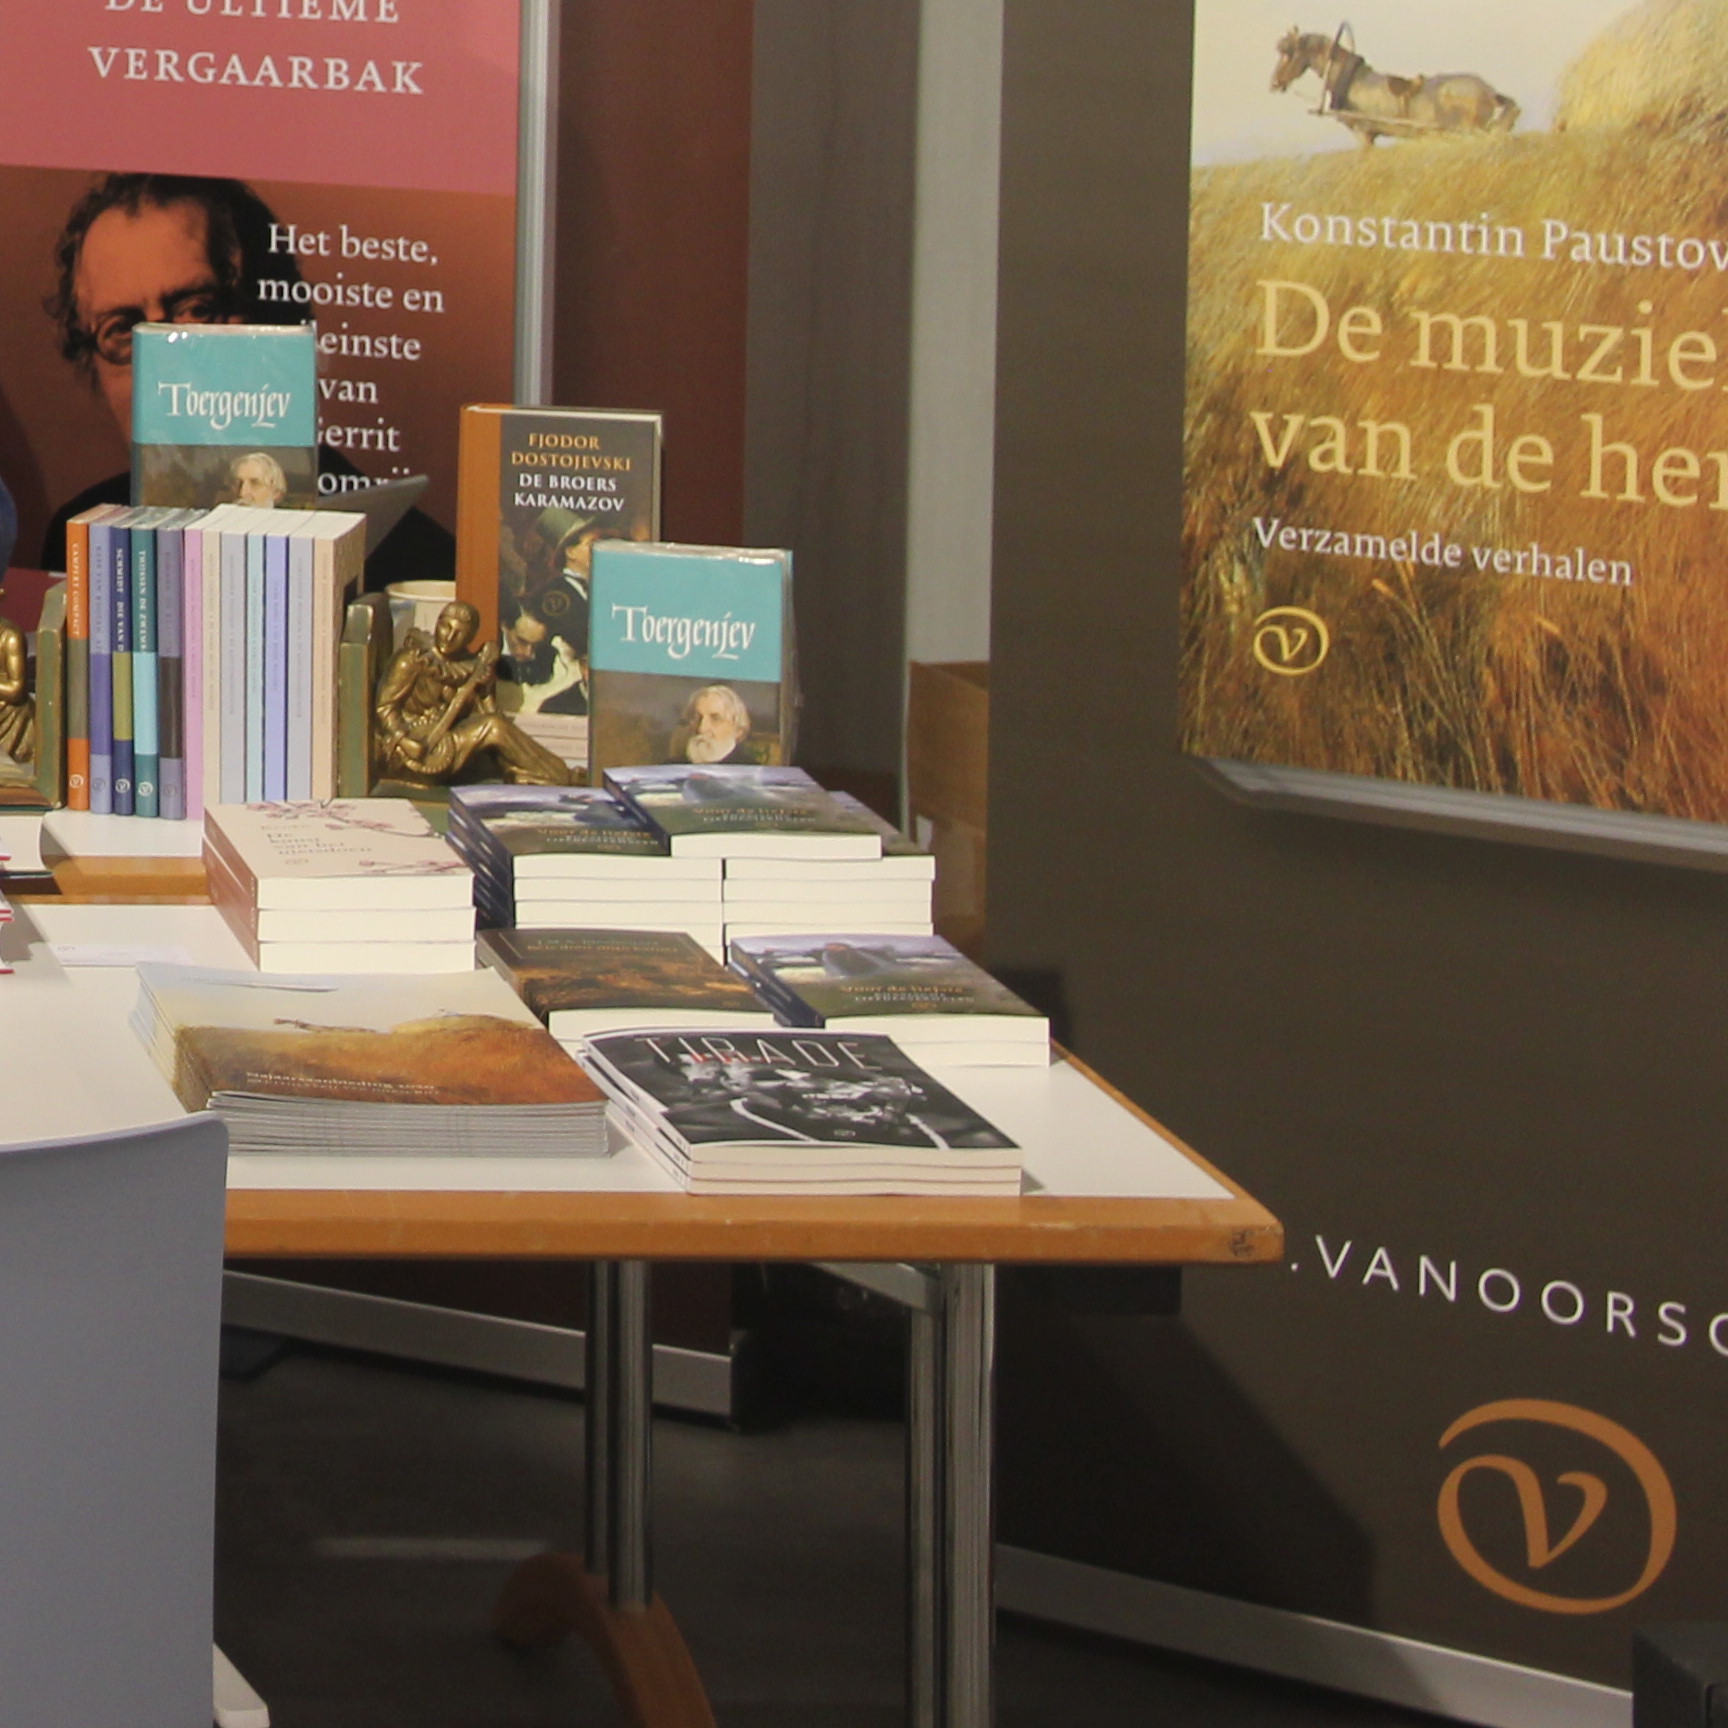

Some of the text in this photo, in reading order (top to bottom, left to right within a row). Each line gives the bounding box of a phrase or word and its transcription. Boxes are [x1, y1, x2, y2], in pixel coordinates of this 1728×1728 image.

[88, 46, 424, 95] VERGAARBAK
[268, 223, 439, 265] Het beste,
[1260, 202, 1525, 257] Konstantin
[258, 272, 444, 313] mooiste en
[1255, 279, 1728, 392] De muzie
[158, 381, 291, 430] Toergenjev
[319, 377, 378, 404] van
[318, 417, 400, 452] errit
[528, 433, 600, 450] FJODOR
[1249, 406, 1417, 480] van
[1446, 405, 1554, 492] de
[511, 452, 631, 471] DOSTOJEVSKI
[519, 473, 617, 492] DE BROERS
[514, 492, 624, 512] KARAMAZOV
[116, 548, 124, 593] SCHMIDT
[1253, 517, 1633, 586] Verzamelde verhalen
[612, 603, 756, 661] Toergenjev
[634, 1036, 883, 1070] TIRADE
